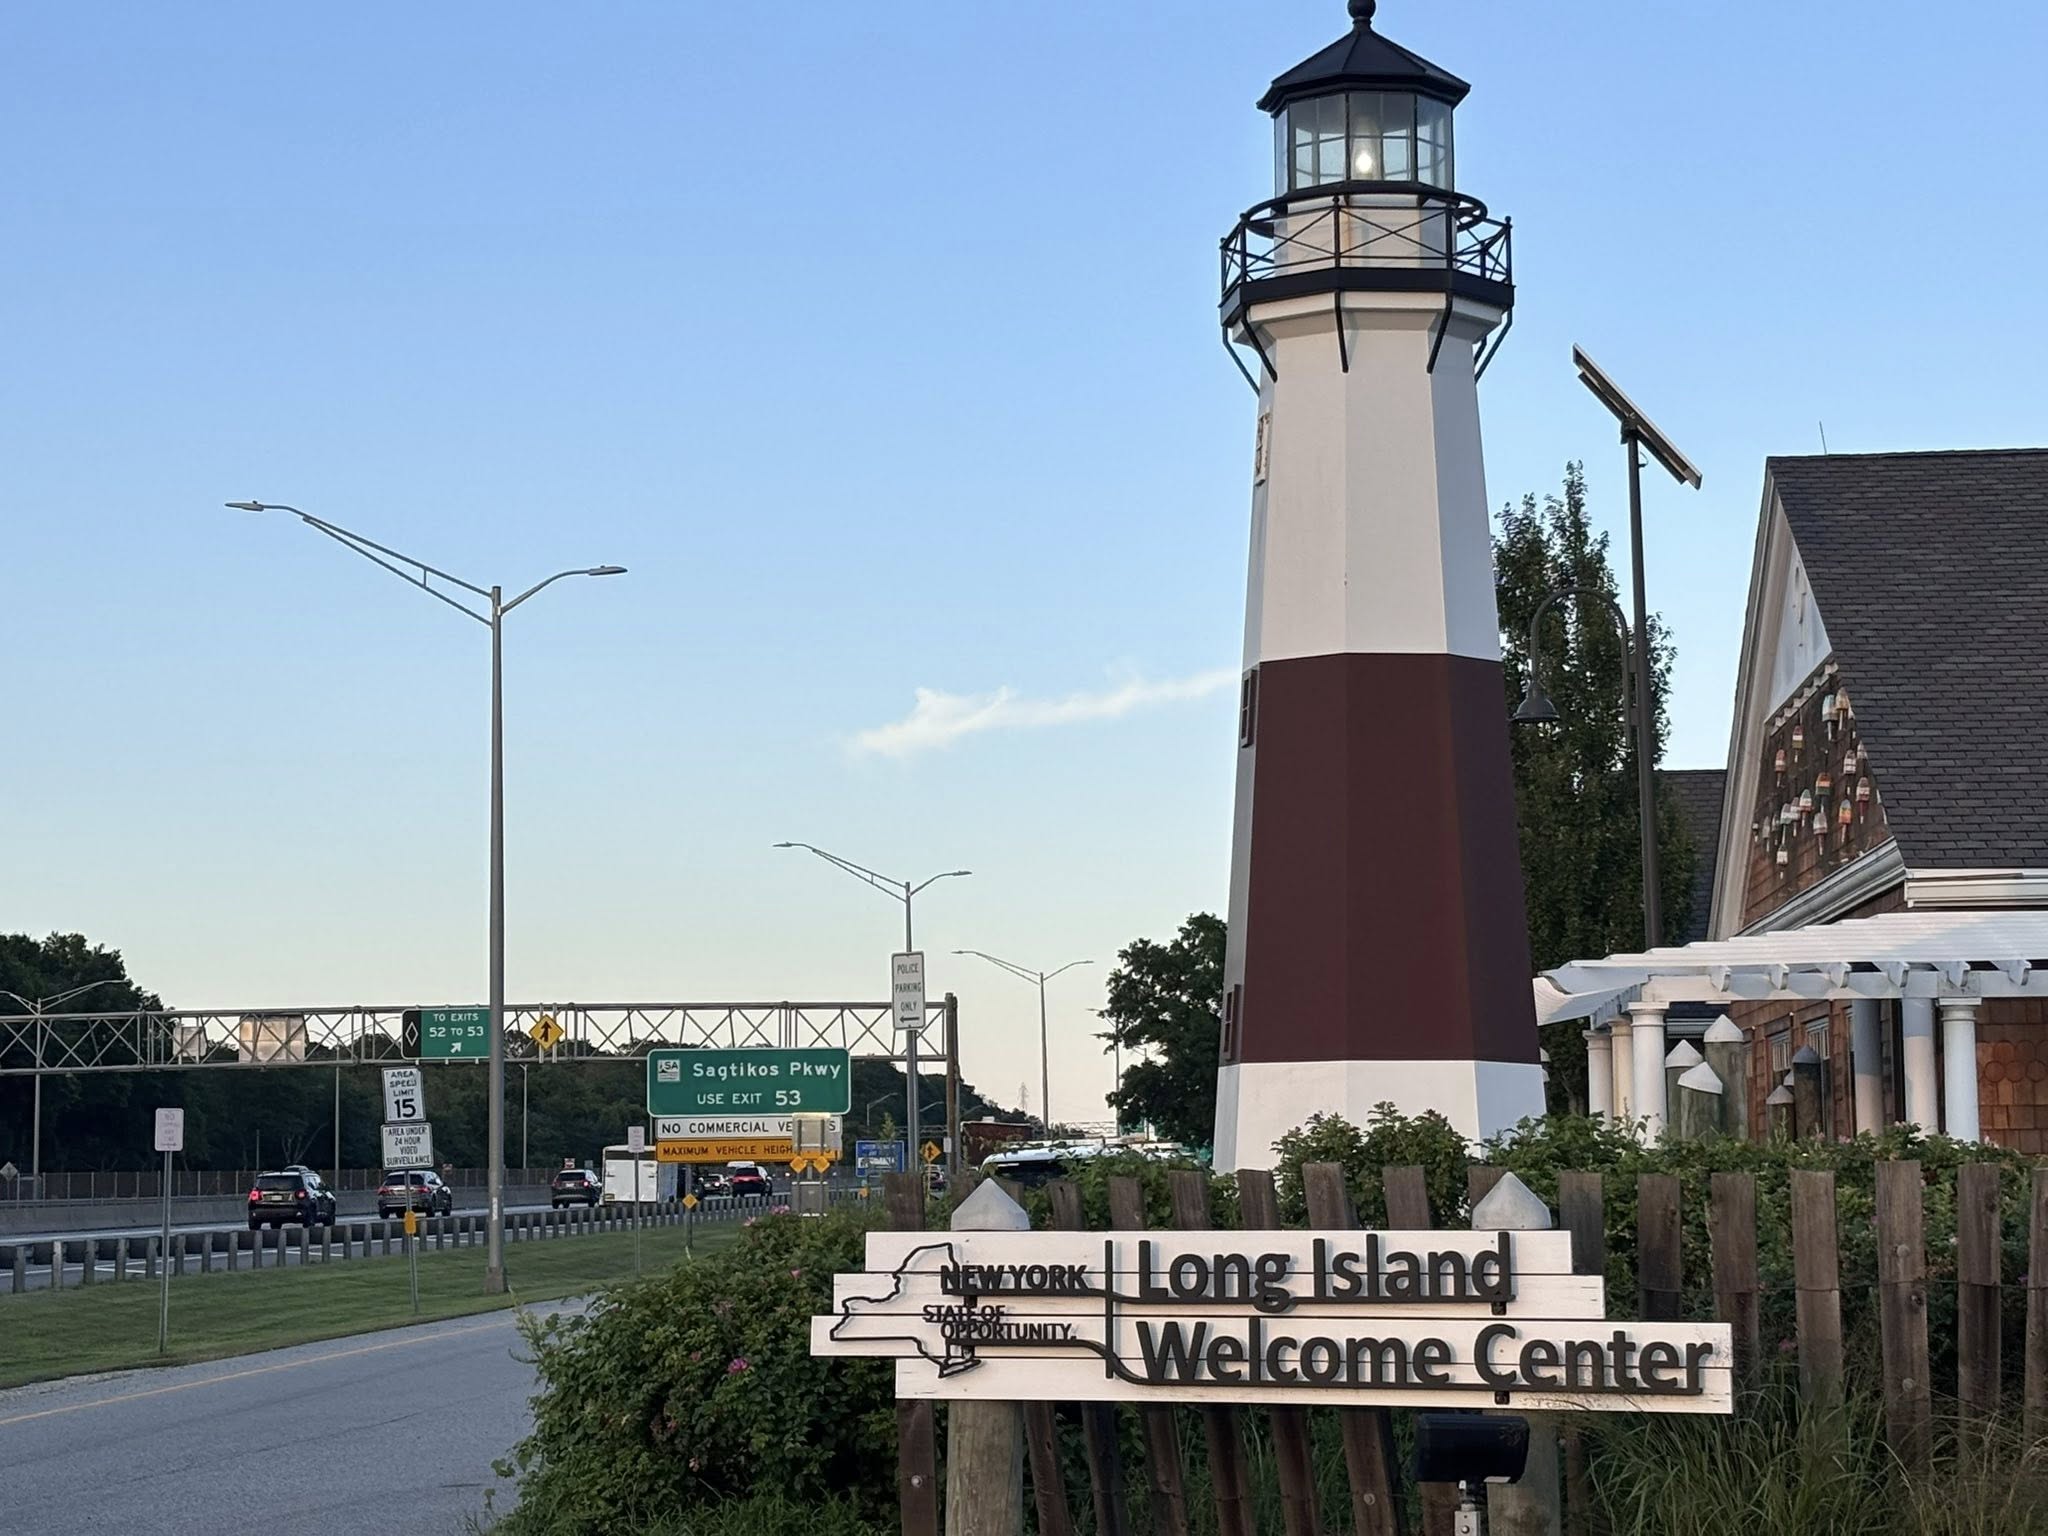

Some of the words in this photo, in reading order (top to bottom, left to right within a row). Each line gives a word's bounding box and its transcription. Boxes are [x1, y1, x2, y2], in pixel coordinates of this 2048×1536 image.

[897, 963, 919, 974] POLICE
[895, 982, 921, 993] PARKING
[900, 1001, 917, 1011] ONLY
[433, 1013, 446, 1021] TO
[450, 1013, 479, 1021] EXITS
[429, 1026, 446, 1037] 52
[450, 1027, 463, 1036] TO
[467, 1026, 484, 1037] 53
[692, 1063, 779, 1081] Sagtikos
[790, 1062, 841, 1079] Pkwy
[389, 1080, 417, 1088] SPEED
[393, 1089, 414, 1097] LIMIT
[697, 1094, 725, 1105] USE
[732, 1093, 762, 1105] EXIT
[775, 1090, 801, 1106] 53
[394, 1098, 416, 1118] 15
[388, 1128, 404, 1136] AREA
[406, 1126, 426, 1135] UNDER
[661, 1123, 681, 1134] NO
[689, 1121, 769, 1134] COMMERCIAL
[394, 1137, 403, 1146] 24
[404, 1136, 421, 1145] HOUR
[400, 1146, 418, 1155] VIDEO
[662, 1146, 709, 1156] MAXIMUM
[715, 1145, 755, 1155] VEHICLE
[763, 1144, 793, 1155] HEIGH
[386, 1155, 430, 1166] SURVEILLANCE
[940, 1264, 1004, 1290] NEW
[1008, 1264, 1089, 1290] YORK
[1138, 1240, 1291, 1313] Long
[1313, 1232, 1512, 1299] Island
[922, 1304, 978, 1323] STATE
[981, 1304, 1006, 1322] OF
[1136, 1317, 1452, 1384] Welcome
[1474, 1324, 1713, 1390] Center
